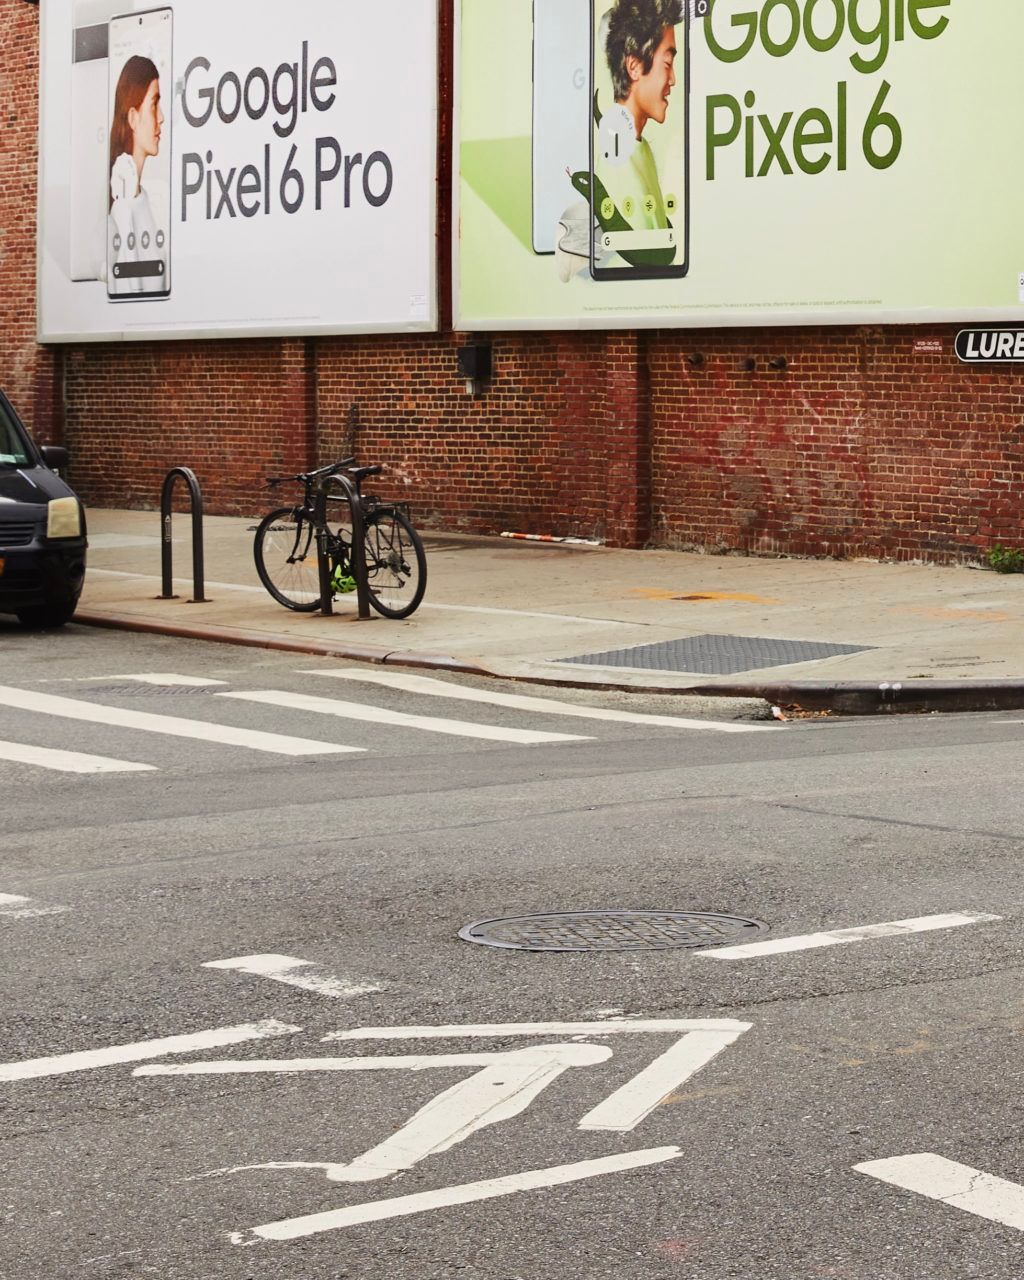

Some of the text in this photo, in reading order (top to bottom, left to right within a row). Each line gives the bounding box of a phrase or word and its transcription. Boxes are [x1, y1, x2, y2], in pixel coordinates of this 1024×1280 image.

[181, 40, 337, 138] Google
[572, 67, 586, 90] G
[705, 79, 903, 181] Pixel 6
[181, 136, 393, 222] Pixel 6 Pro
[604, 236, 611, 246] G
